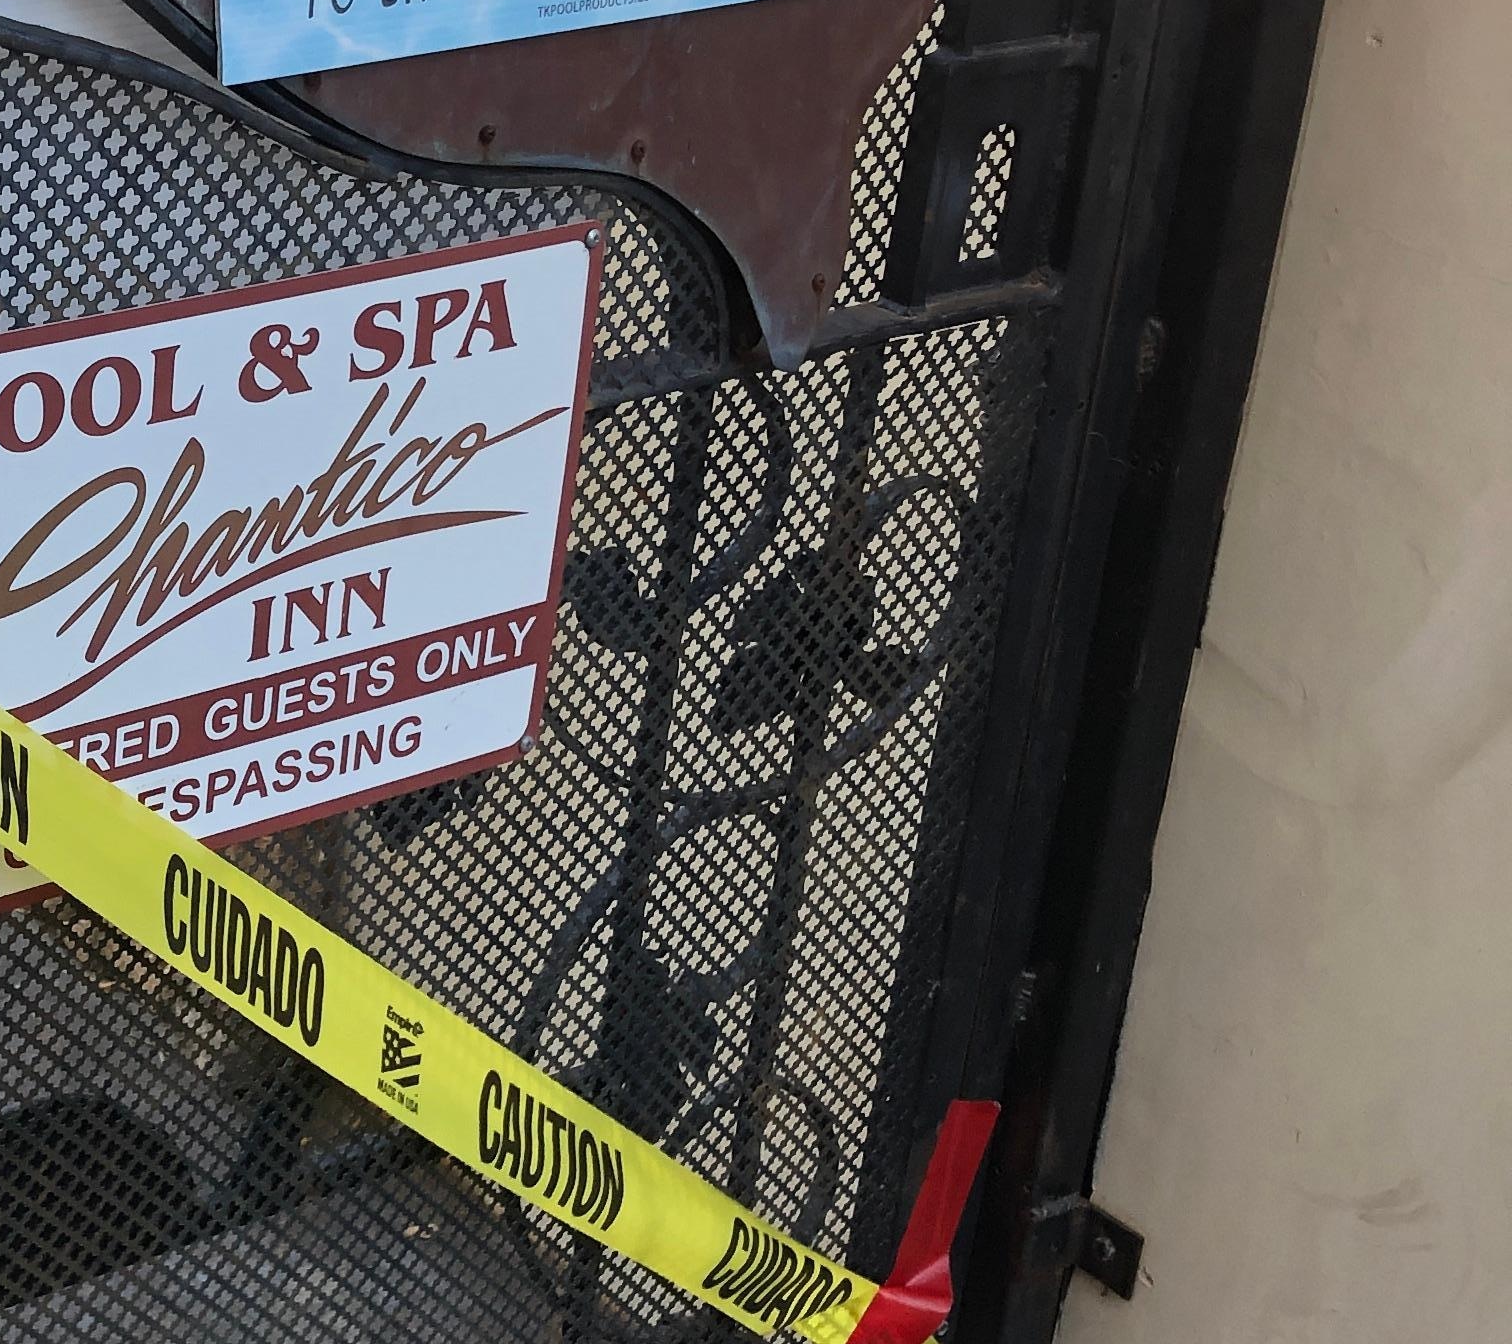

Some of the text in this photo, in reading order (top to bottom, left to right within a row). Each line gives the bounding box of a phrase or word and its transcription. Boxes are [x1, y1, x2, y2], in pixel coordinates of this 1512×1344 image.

[238, 324, 319, 403] &
[349, 279, 518, 382] SPA
[247, 567, 392, 662] INN
[204, 655, 395, 741] GUESTS
[416, 616, 537, 683] ONLY
[164, 853, 324, 1047] CUIDADO
[479, 1070, 624, 1231] CAUTION
